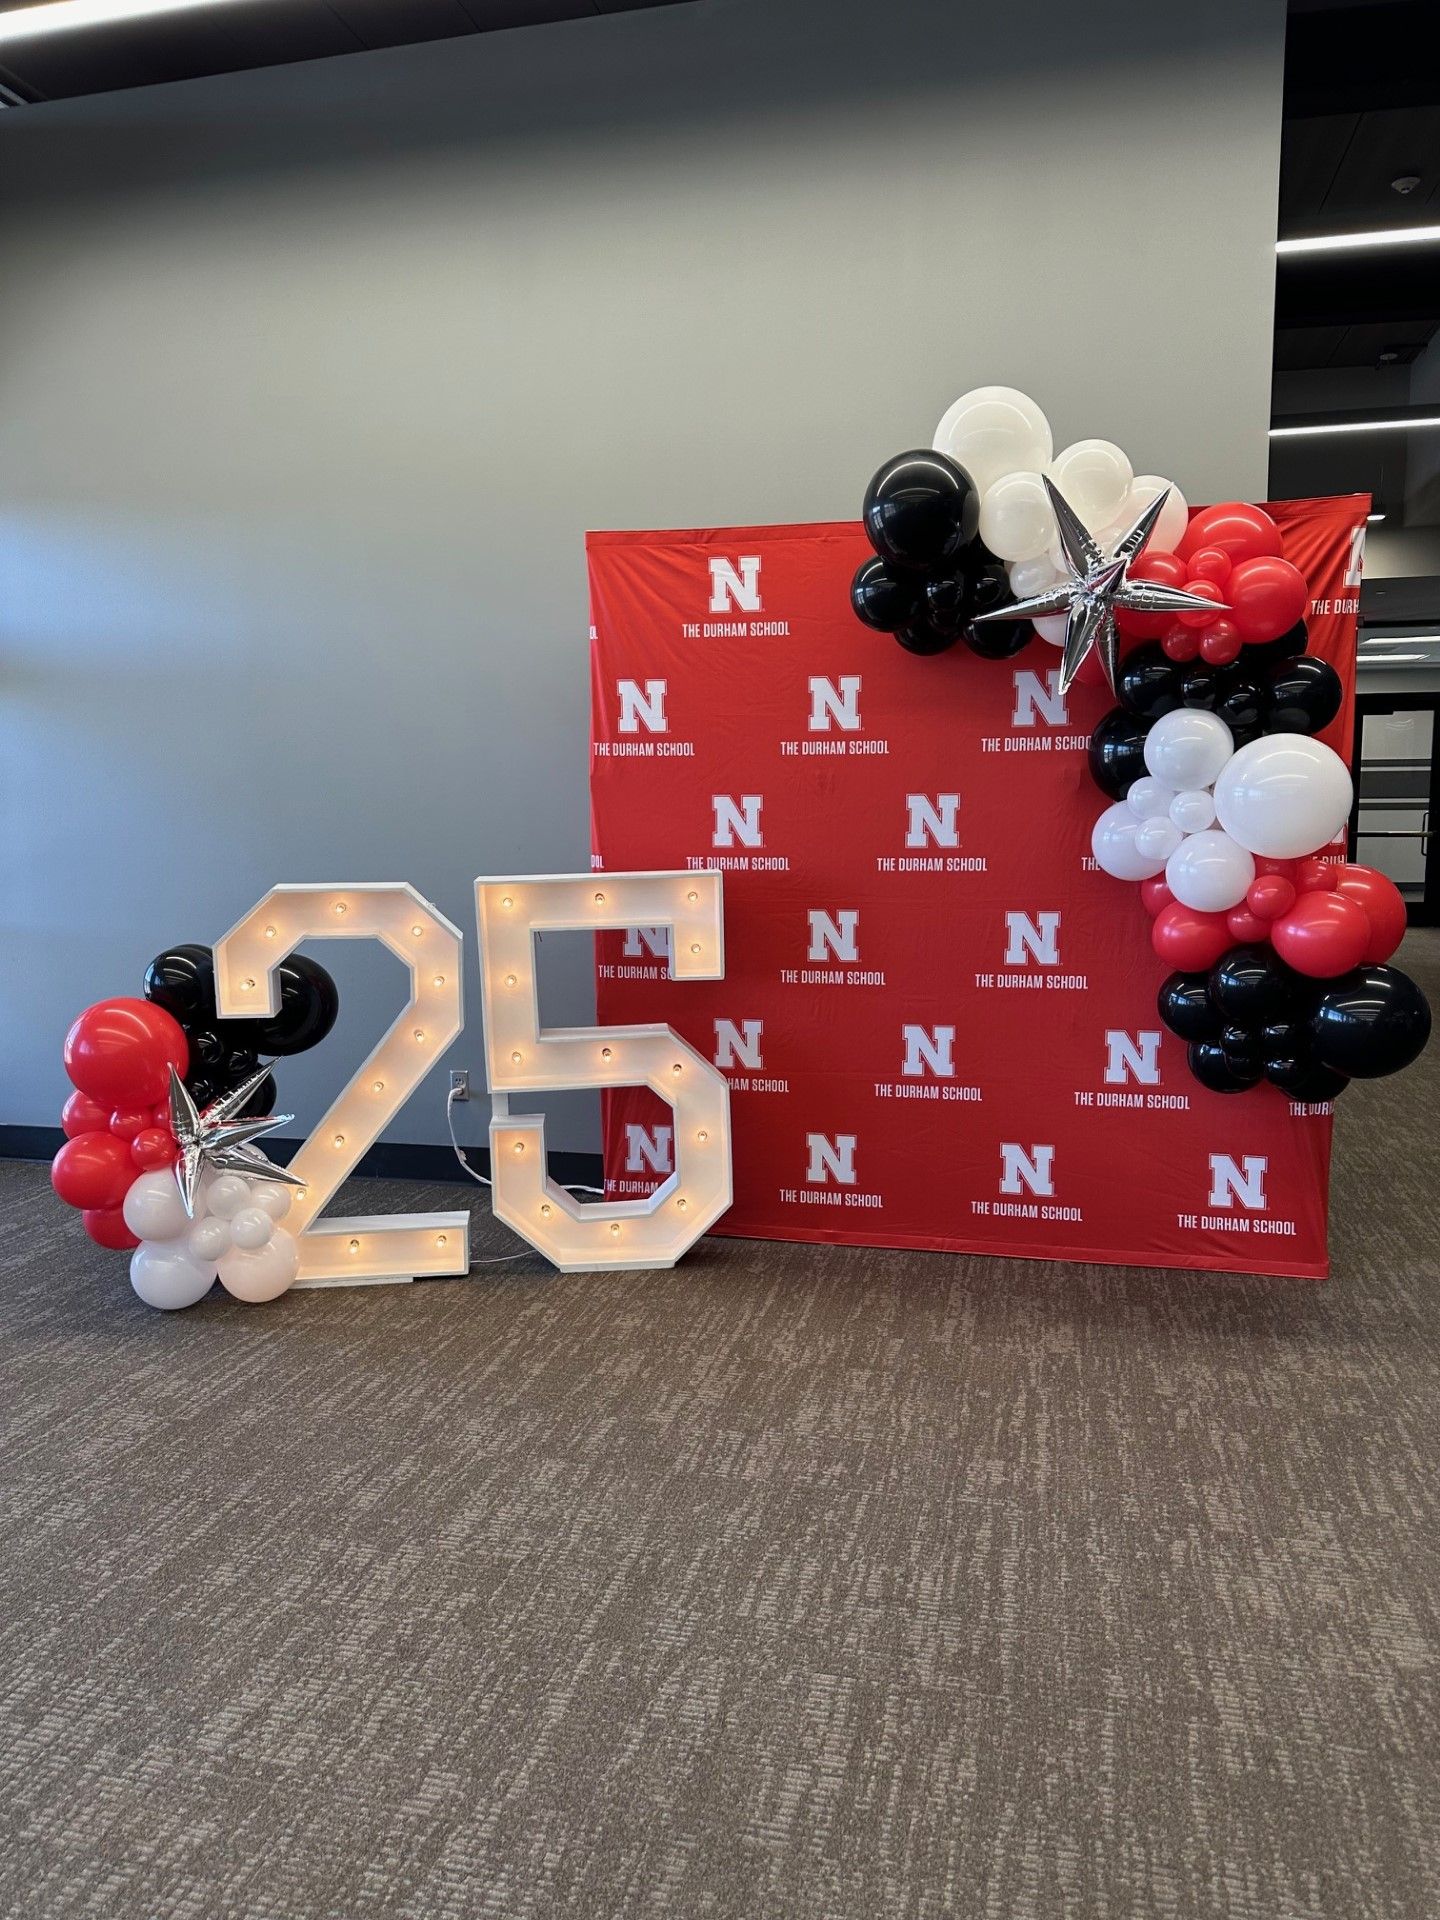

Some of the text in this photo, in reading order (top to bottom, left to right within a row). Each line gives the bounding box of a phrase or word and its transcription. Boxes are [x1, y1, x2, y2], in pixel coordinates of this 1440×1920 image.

[708, 555, 762, 613] N
[1311, 599, 1331, 615] THE
[682, 621, 790, 638] THE DURHAM SCHOOL
[616, 678, 668, 733] N
[808, 675, 862, 731] N
[1011, 668, 1070, 728] N
[593, 742, 695, 757] THE DURHAM SCHOOL
[780, 740, 890, 756] THE DURHAM SCHOOL
[981, 735, 1092, 752] THE DURHAM SCHOO
[712, 795, 763, 848] N
[907, 793, 961, 848] N
[686, 856, 790, 871] THE DURHAM SCHOOL
[877, 857, 987, 872] THE DURHAM SCHOOL
[623, 927, 669, 958] N
[807, 909, 860, 963] N
[1004, 910, 1061, 966] N
[598, 965, 615, 978] THE
[617, 965, 658, 980] DURHAM
[780, 969, 886, 986] THE DURHAM SCHOOL
[975, 973, 1088, 990] THE DURHAM SCHOOL
[713, 1017, 764, 1070] N
[901, 1023, 957, 1077] N
[1104, 1029, 1163, 1085] N
[751, 1078, 790, 1093] SCHOOL
[874, 1083, 983, 1102] THE DURHAM SCHOOL
[1075, 1091, 1190, 1110] THE DURHAM SCHOOL
[1289, 1101, 1308, 1116] THE
[625, 1122, 673, 1174] N
[806, 1132, 857, 1185] N
[999, 1142, 1055, 1198] N
[619, 1180, 659, 1194] DURHAM
[1208, 1152, 1269, 1211] N
[779, 1188, 884, 1209] THE DURHAM SCHOOL
[971, 1200, 1083, 1222] THE DURHAM SCHOOL
[1177, 1214, 1297, 1236] THE DURHAM SCHOOL
